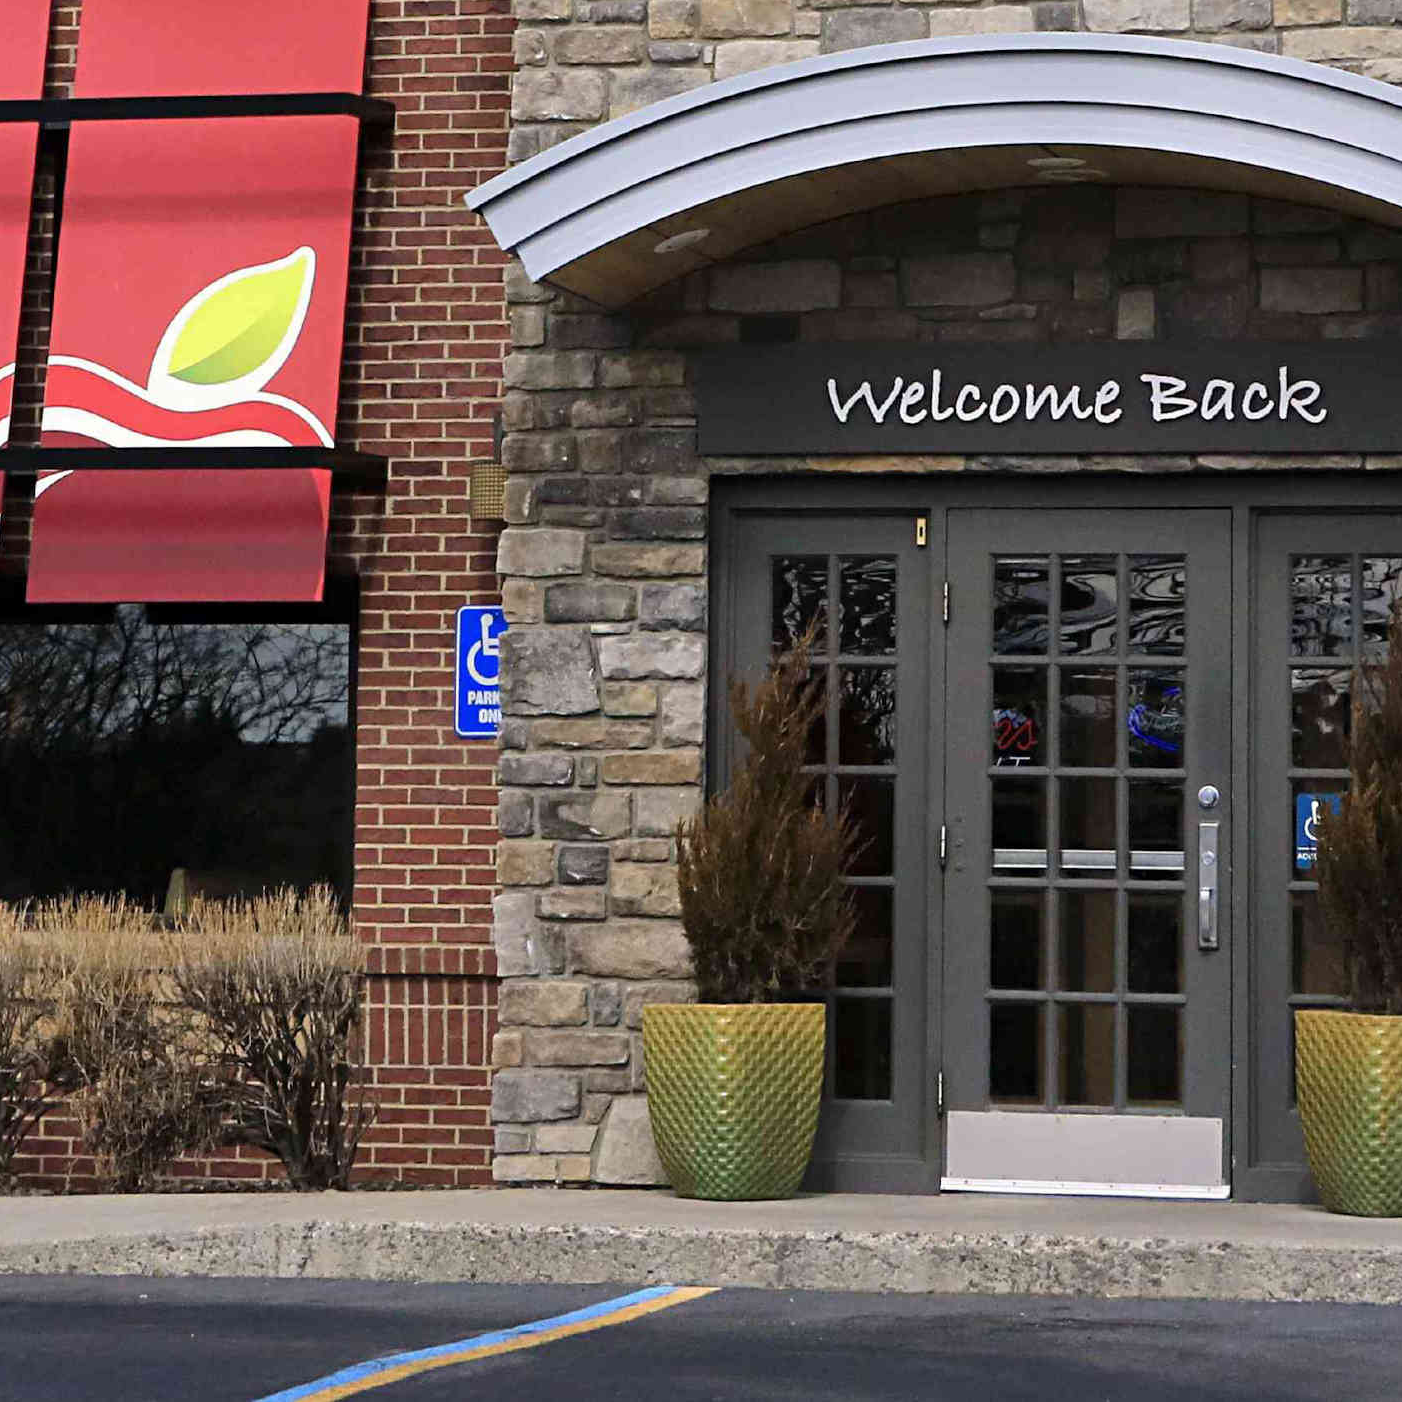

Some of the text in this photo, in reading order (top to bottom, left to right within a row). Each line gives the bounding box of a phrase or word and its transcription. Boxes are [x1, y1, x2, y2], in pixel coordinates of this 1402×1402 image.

[827, 366, 1327, 425] Welcome Back
[467, 690, 501, 705] PARK
